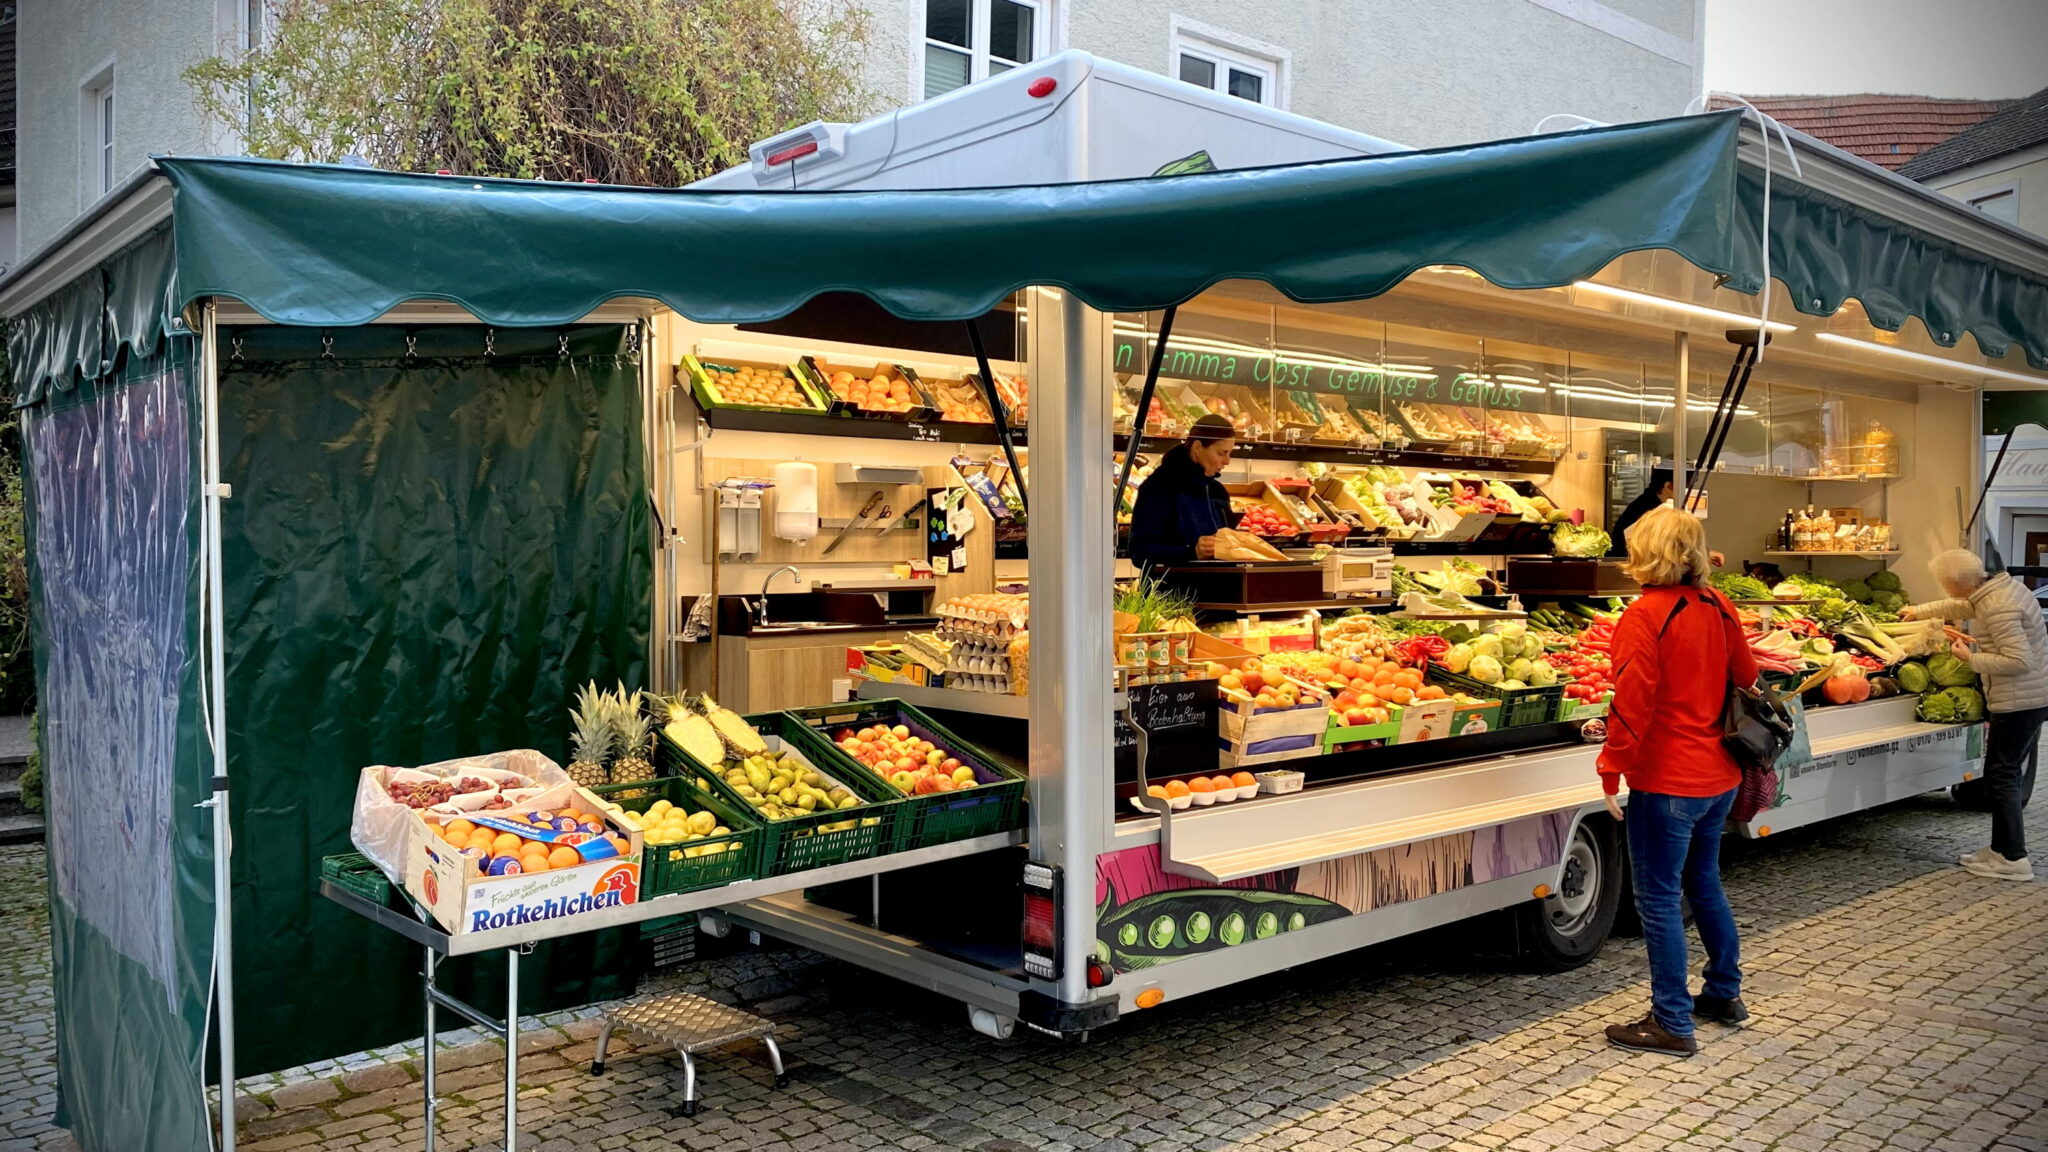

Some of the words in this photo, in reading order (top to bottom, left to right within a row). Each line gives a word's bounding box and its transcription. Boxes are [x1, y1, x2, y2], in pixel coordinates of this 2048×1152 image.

[1253, 355, 1313, 387] Obst
[1426, 376, 1439, 399] &
[1451, 375, 1524, 408] Genuss
[1999, 450, 2048, 476] Hau
[1148, 685, 1168, 706] Eier
[1176, 692, 1195, 702] aus
[490, 886, 521, 909] Früchte
[520, 883, 549, 900] unseren
[550, 872, 578, 888] Gärten
[470, 889, 621, 933] Rotkehlchen
